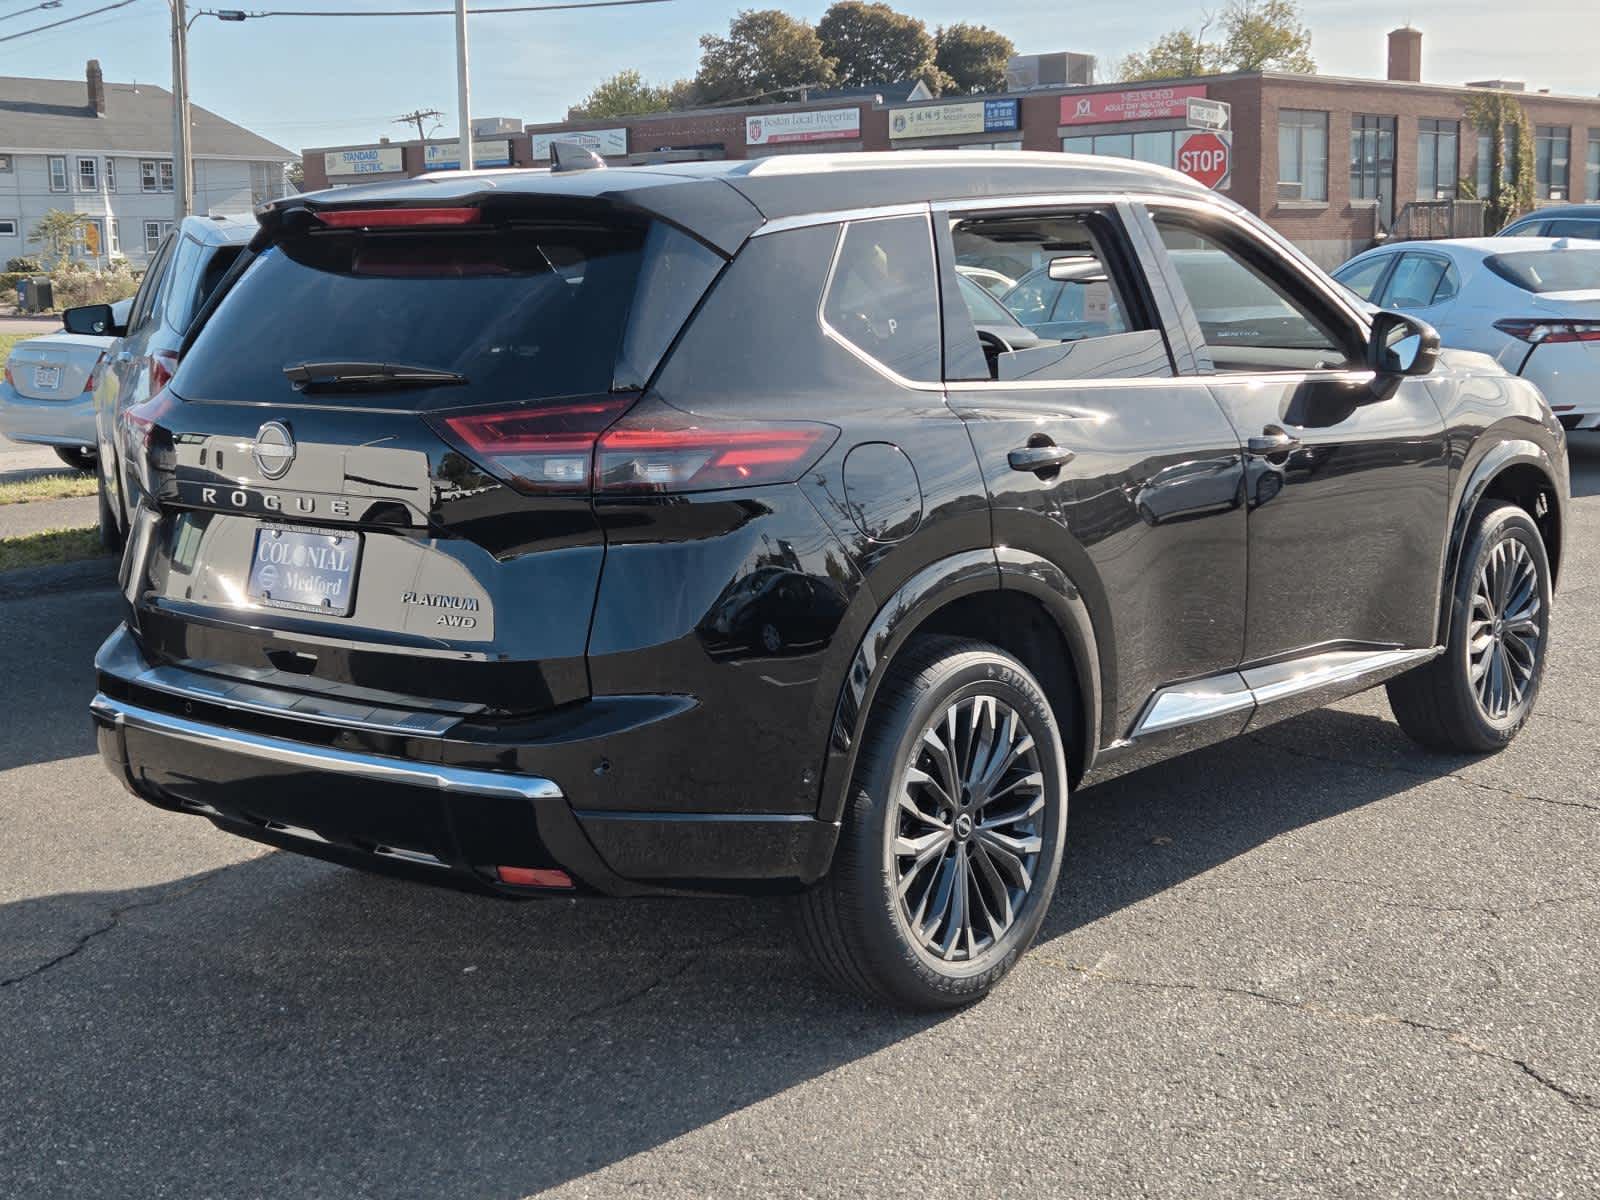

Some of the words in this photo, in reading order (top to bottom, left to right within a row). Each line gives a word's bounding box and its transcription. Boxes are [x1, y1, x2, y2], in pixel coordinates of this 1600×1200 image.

[1120, 89, 1174, 103] MEDFORD
[792, 112, 813, 125] Local
[815, 109, 857, 124] Properties
[343, 150, 378, 161] STANDARD
[1180, 150, 1225, 172] STOP
[353, 162, 384, 172] ELECTRIC
[202, 487, 350, 516] ROGUE
[258, 540, 350, 572] COLONIAL
[284, 571, 343, 595] Medford
[401, 591, 479, 611] PLATINUM
[436, 615, 477, 628] AWD
